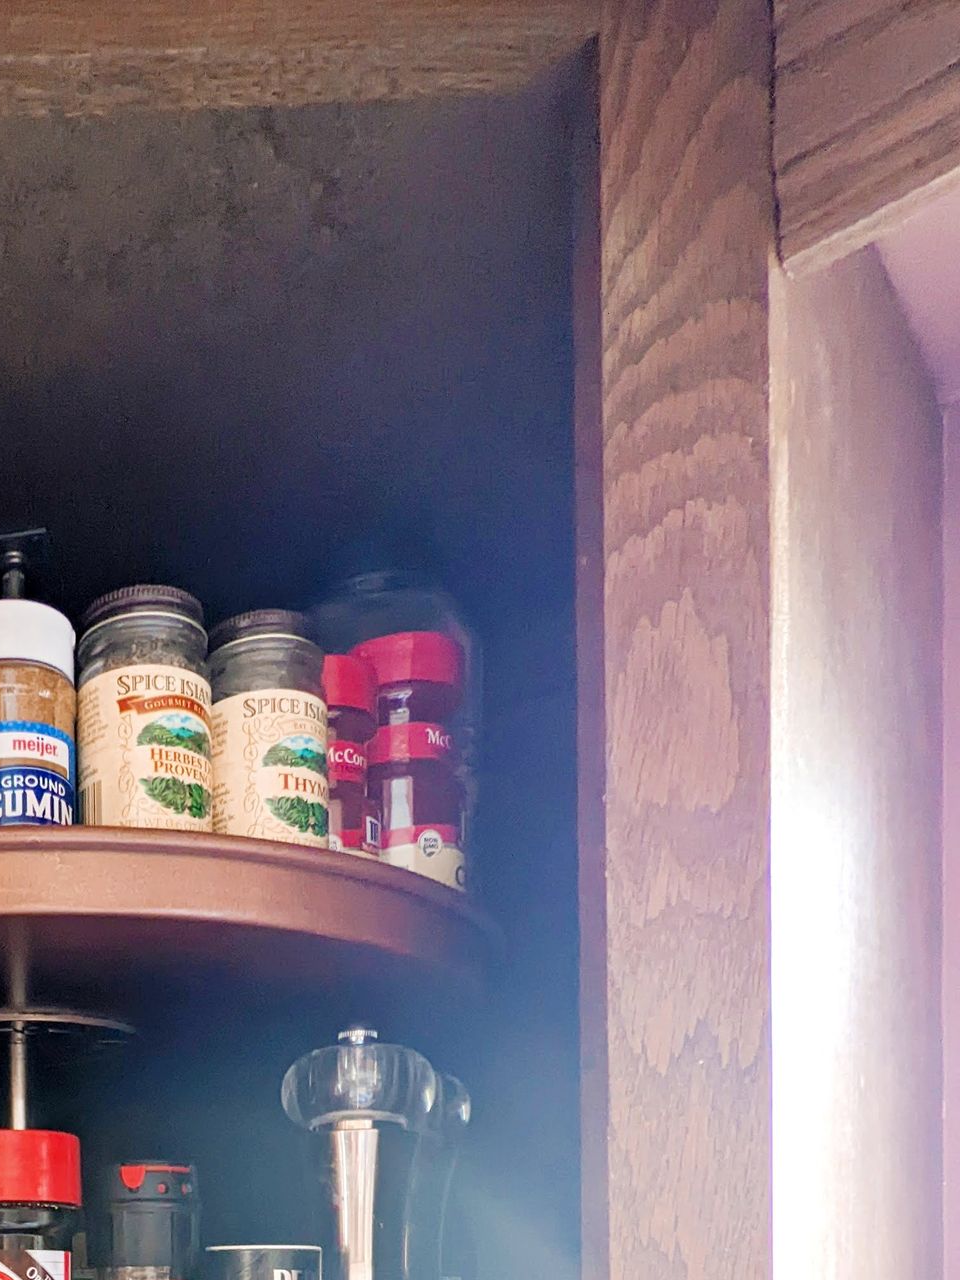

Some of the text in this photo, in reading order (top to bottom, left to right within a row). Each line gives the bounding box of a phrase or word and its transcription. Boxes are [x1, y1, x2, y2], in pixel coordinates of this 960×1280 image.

[117, 674, 177, 696] SPICE
[242, 698, 300, 718] SPICE
[12, 737, 58, 757] meijer
[150, 748, 201, 769] HERBES
[1, 775, 66, 797] GROUND
